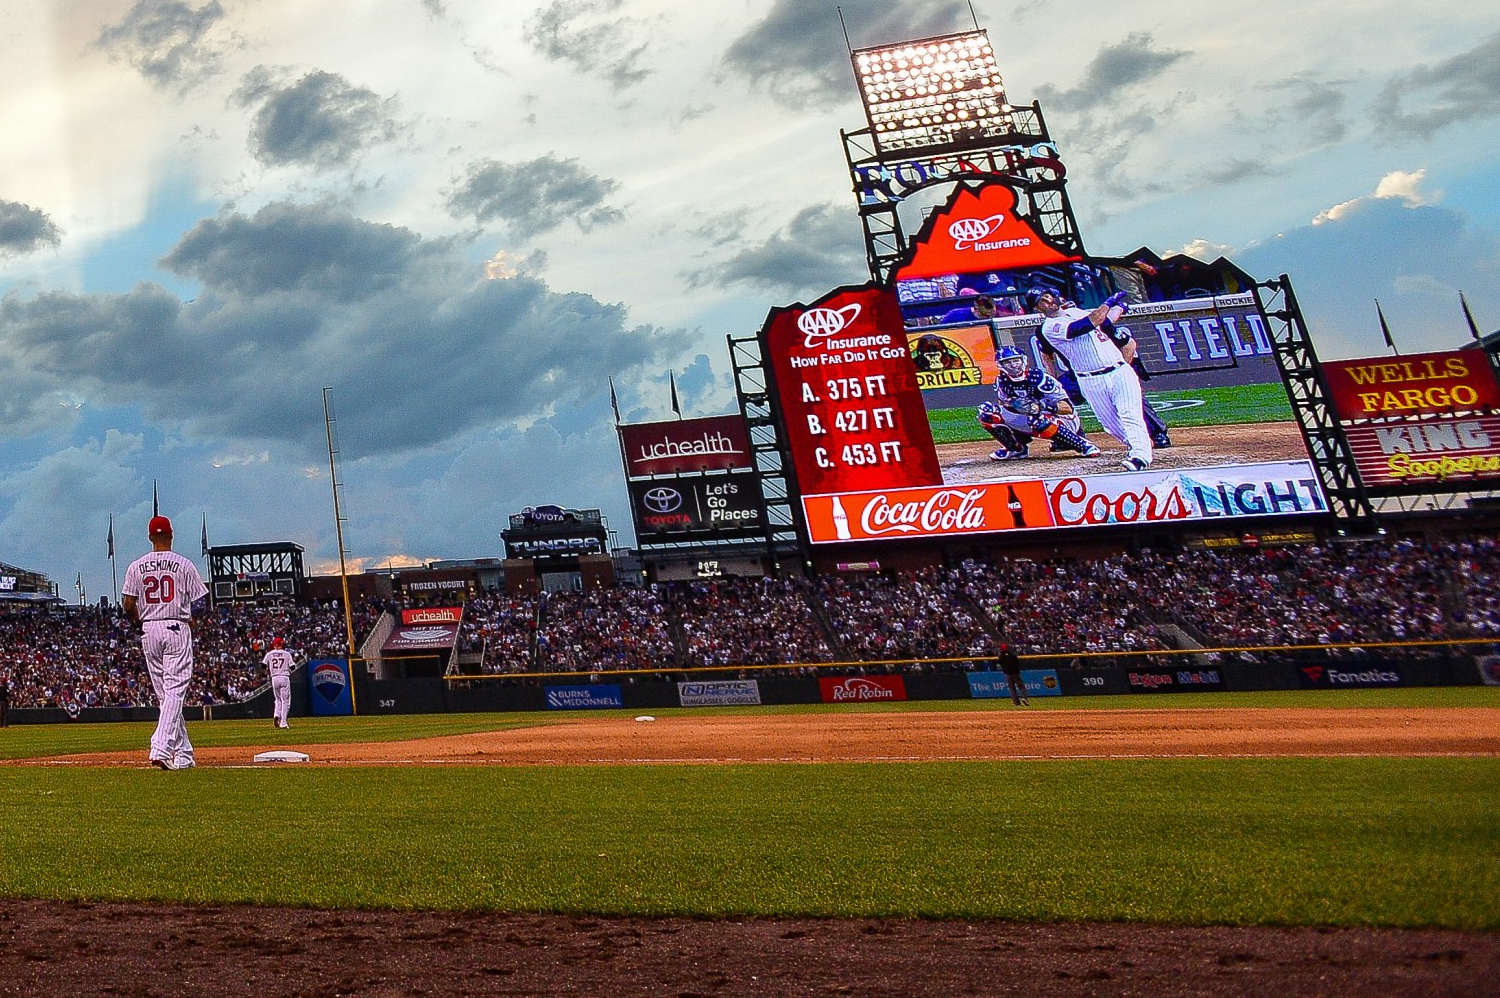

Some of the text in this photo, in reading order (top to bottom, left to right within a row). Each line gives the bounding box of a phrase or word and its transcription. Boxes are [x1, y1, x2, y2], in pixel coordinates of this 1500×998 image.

[852, 141, 1067, 205] ROCKIES
[974, 237, 1031, 251] Insurance
[802, 311, 842, 334] AAA
[827, 334, 891, 350] Insurance
[1344, 358, 1470, 385] WELLS
[802, 375, 886, 403] A. 375 FT
[1357, 385, 1479, 412] FARGO
[806, 407, 894, 435] B. 427 FT
[640, 431, 733, 459] uchealth
[1374, 422, 1492, 454] KING
[815, 441, 901, 468] C. 453 FT
[1388, 453, 1500, 478] Soopers
[706, 483, 738, 496] Let's
[707, 497, 727, 508] Go
[1050, 477, 1323, 526] Coors LIGHT
[531, 512, 564, 522] TOYOTA
[644, 515, 691, 525] TOYOTA
[710, 509, 758, 522] Places
[509, 537, 600, 552] TUNDRA
[139, 559, 180, 575] DESMOND
[143, 574, 175, 604] 20
[410, 580, 465, 591] FROZEN YOGURT
[411, 609, 455, 622] uchealth
[271, 658, 285, 669] 27
[1083, 677, 1104, 686] 390
[1128, 671, 1219, 688] Exxon Mobil
[1328, 669, 1399, 683] Fanatics
[833, 685, 893, 700] Red Robin
[972, 683, 990, 691] The
[992, 682, 1010, 691] UP
[558, 691, 590, 699] BURNS
